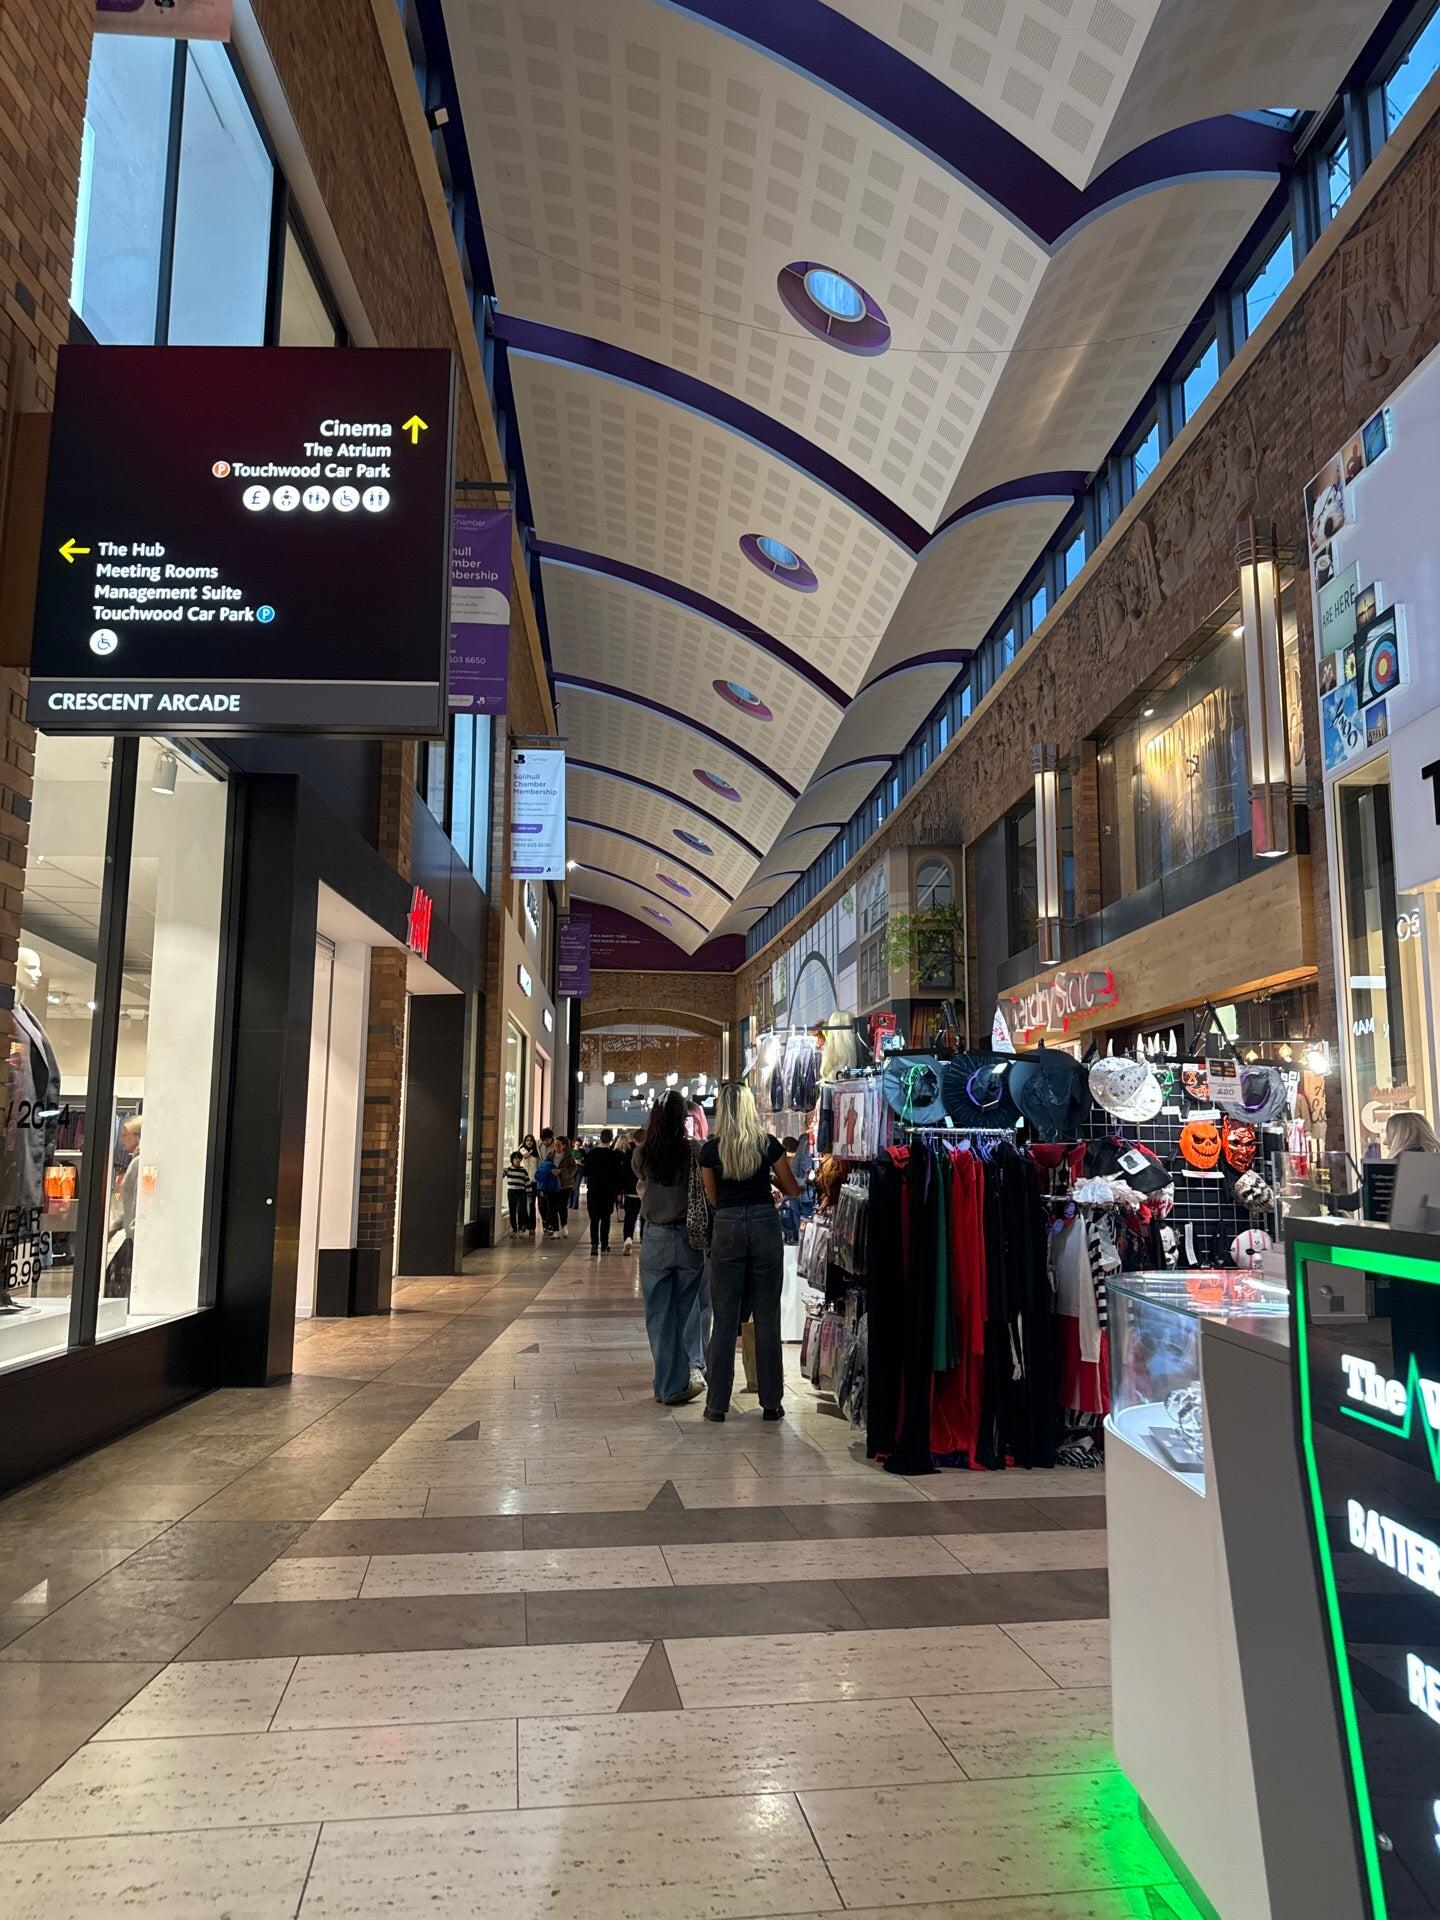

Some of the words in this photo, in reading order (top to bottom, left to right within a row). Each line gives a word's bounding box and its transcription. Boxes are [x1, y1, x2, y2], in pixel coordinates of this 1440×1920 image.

[319, 419, 393, 438] Cinema
[303, 442, 334, 458] The
[336, 442, 392, 458] Atrium
[232, 462, 321, 479] Touchwood
[324, 463, 353, 479] Car
[356, 463, 391, 479] Park
[98, 542, 128, 557] The
[131, 542, 166, 558] Hub
[95, 563, 162, 583] Meeting
[164, 563, 219, 579] Rooms
[94, 584, 198, 604] Management
[201, 585, 243, 601] Suite
[92, 605, 184, 621] Touchwood
[186, 606, 216, 622] Car
[218, 606, 255, 622] Park
[1322, 606, 1334, 629] ARE
[1334, 583, 1356, 619] HERE
[47, 692, 154, 712] CRESCENT
[156, 693, 241, 712] ARCADE
[512, 788, 558, 796] Membership
[1216, 1088, 1235, 1096] £20
[1341, 1353, 1408, 1417] The
